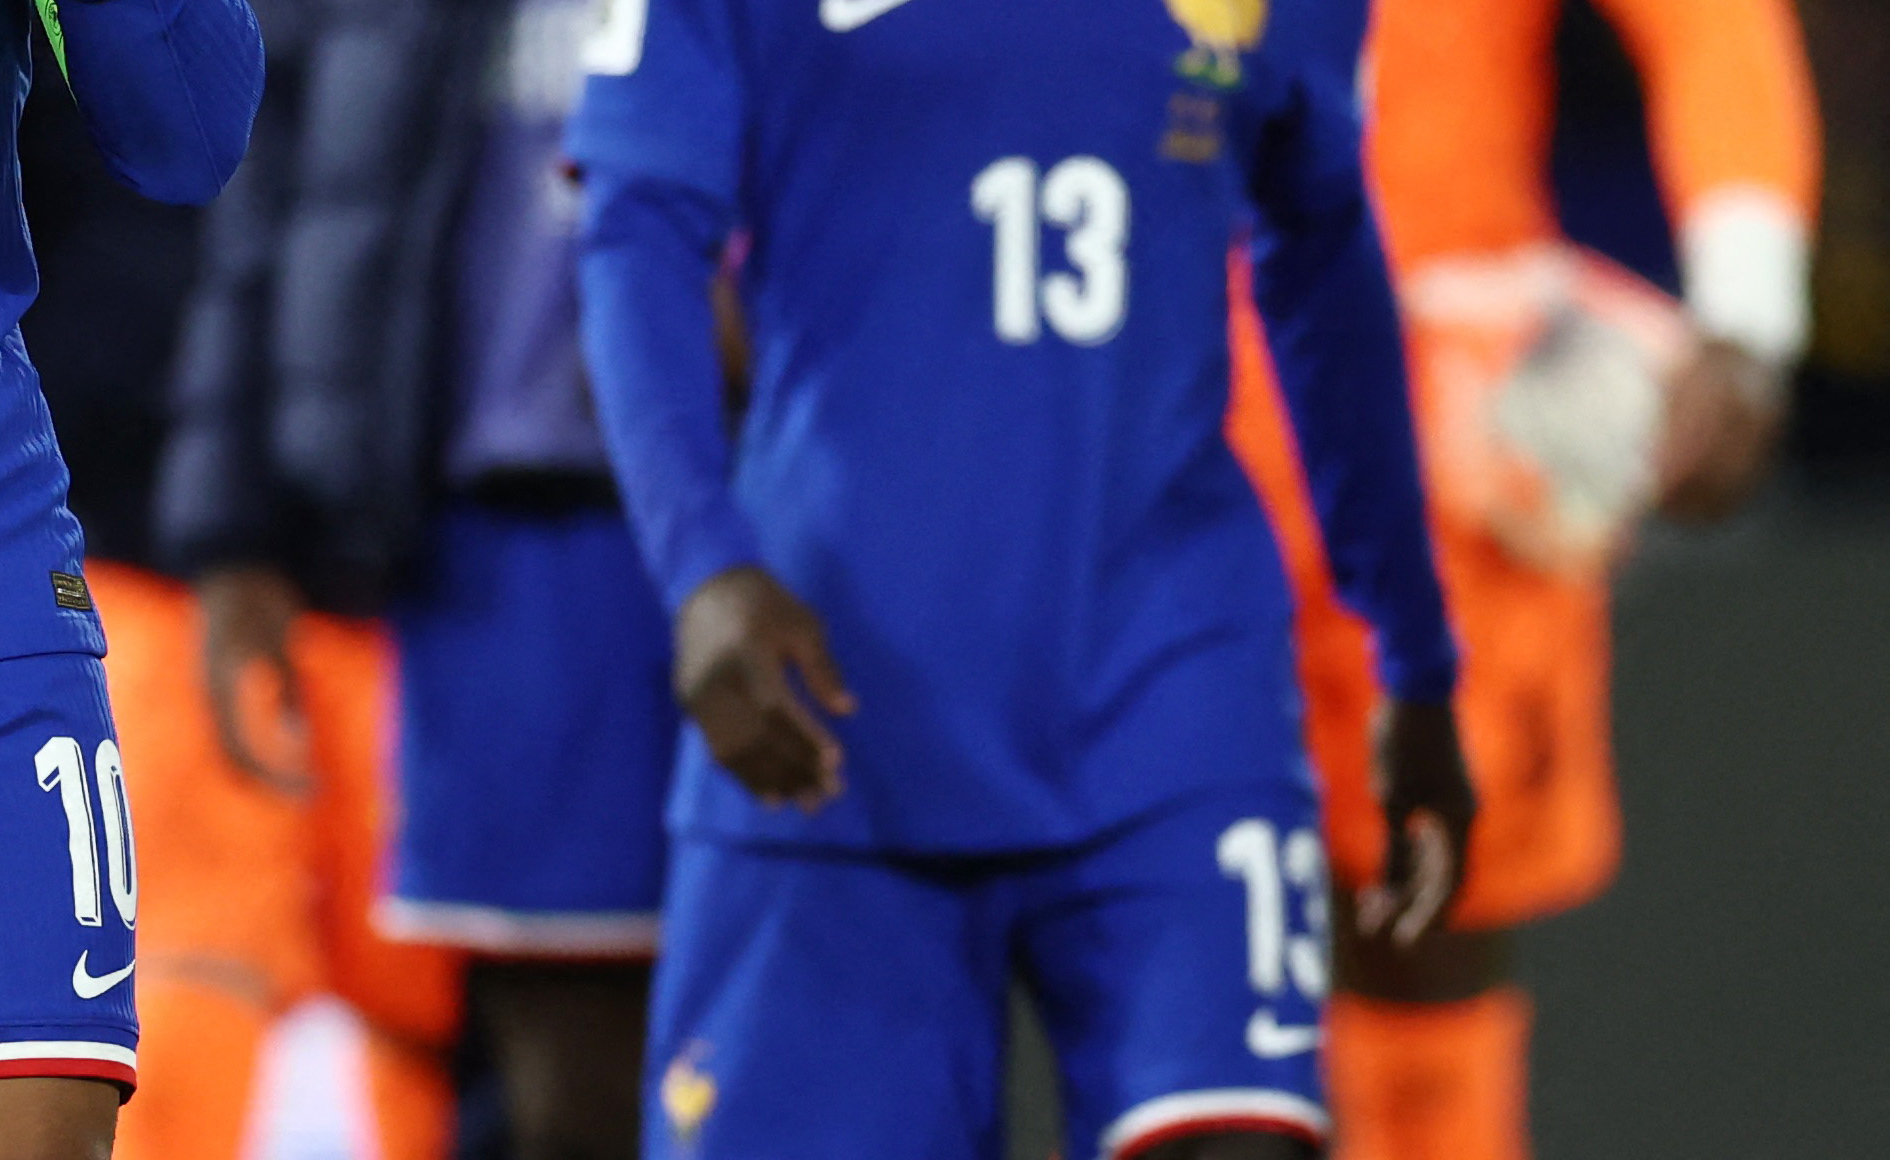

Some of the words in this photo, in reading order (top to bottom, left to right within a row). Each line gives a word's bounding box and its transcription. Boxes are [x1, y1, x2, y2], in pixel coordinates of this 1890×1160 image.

[970, 154, 1129, 346] 13
[33, 736, 138, 931] 10
[1216, 816, 1330, 997] 13
